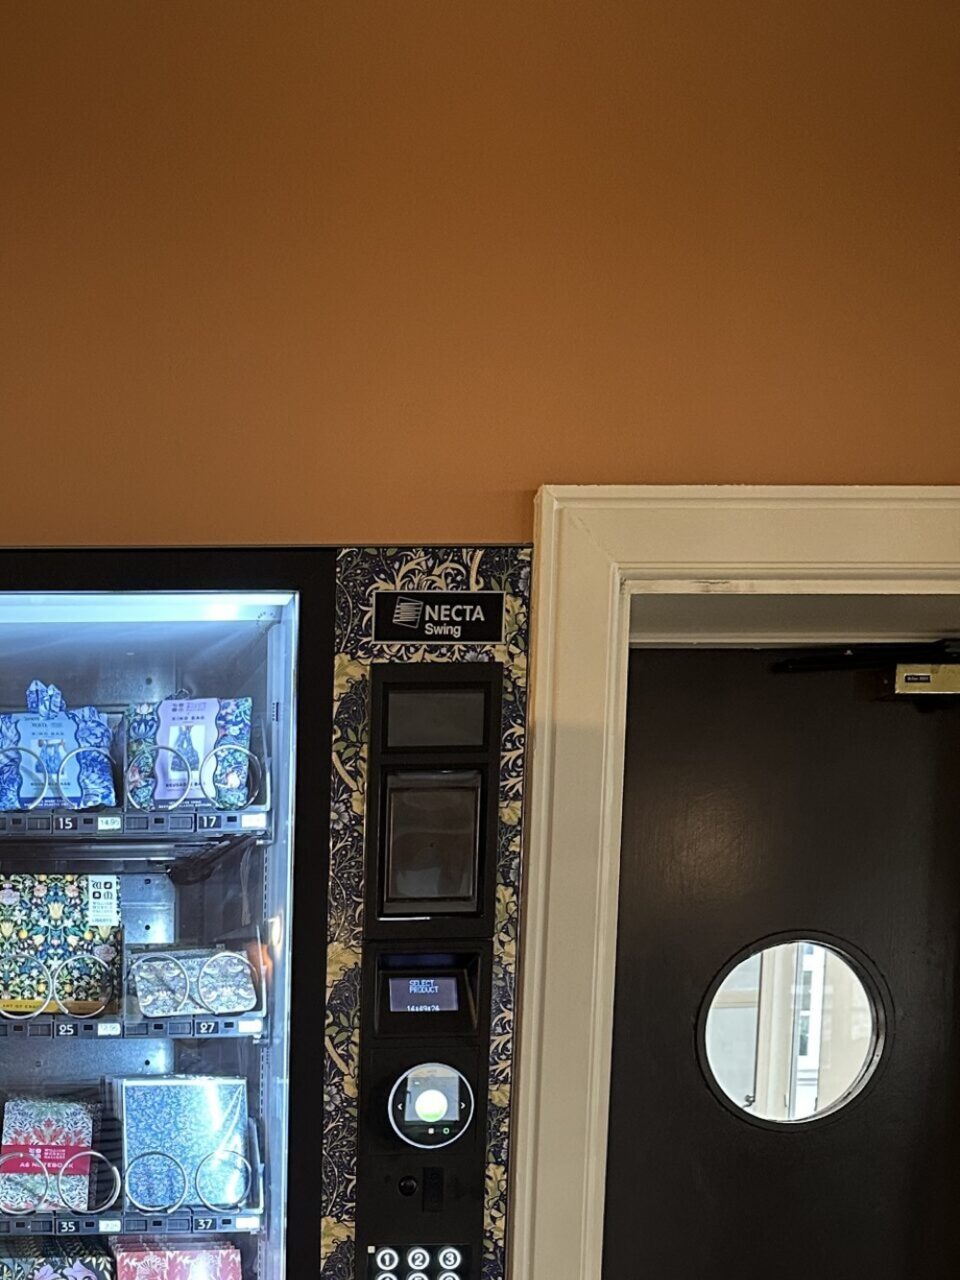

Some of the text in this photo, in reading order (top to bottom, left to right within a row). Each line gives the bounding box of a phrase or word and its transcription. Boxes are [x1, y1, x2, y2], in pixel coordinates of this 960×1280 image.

[424, 605, 486, 621] NECTA
[424, 623, 462, 638] Swing
[59, 817, 73, 830] 15
[202, 816, 217, 828] 17
[58, 1024, 74, 1035] 25
[200, 1022, 215, 1033] 27
[60, 1220, 76, 1232] 35
[198, 1218, 212, 1229] 37
[384, 1254, 454, 1266] 1 2 3
